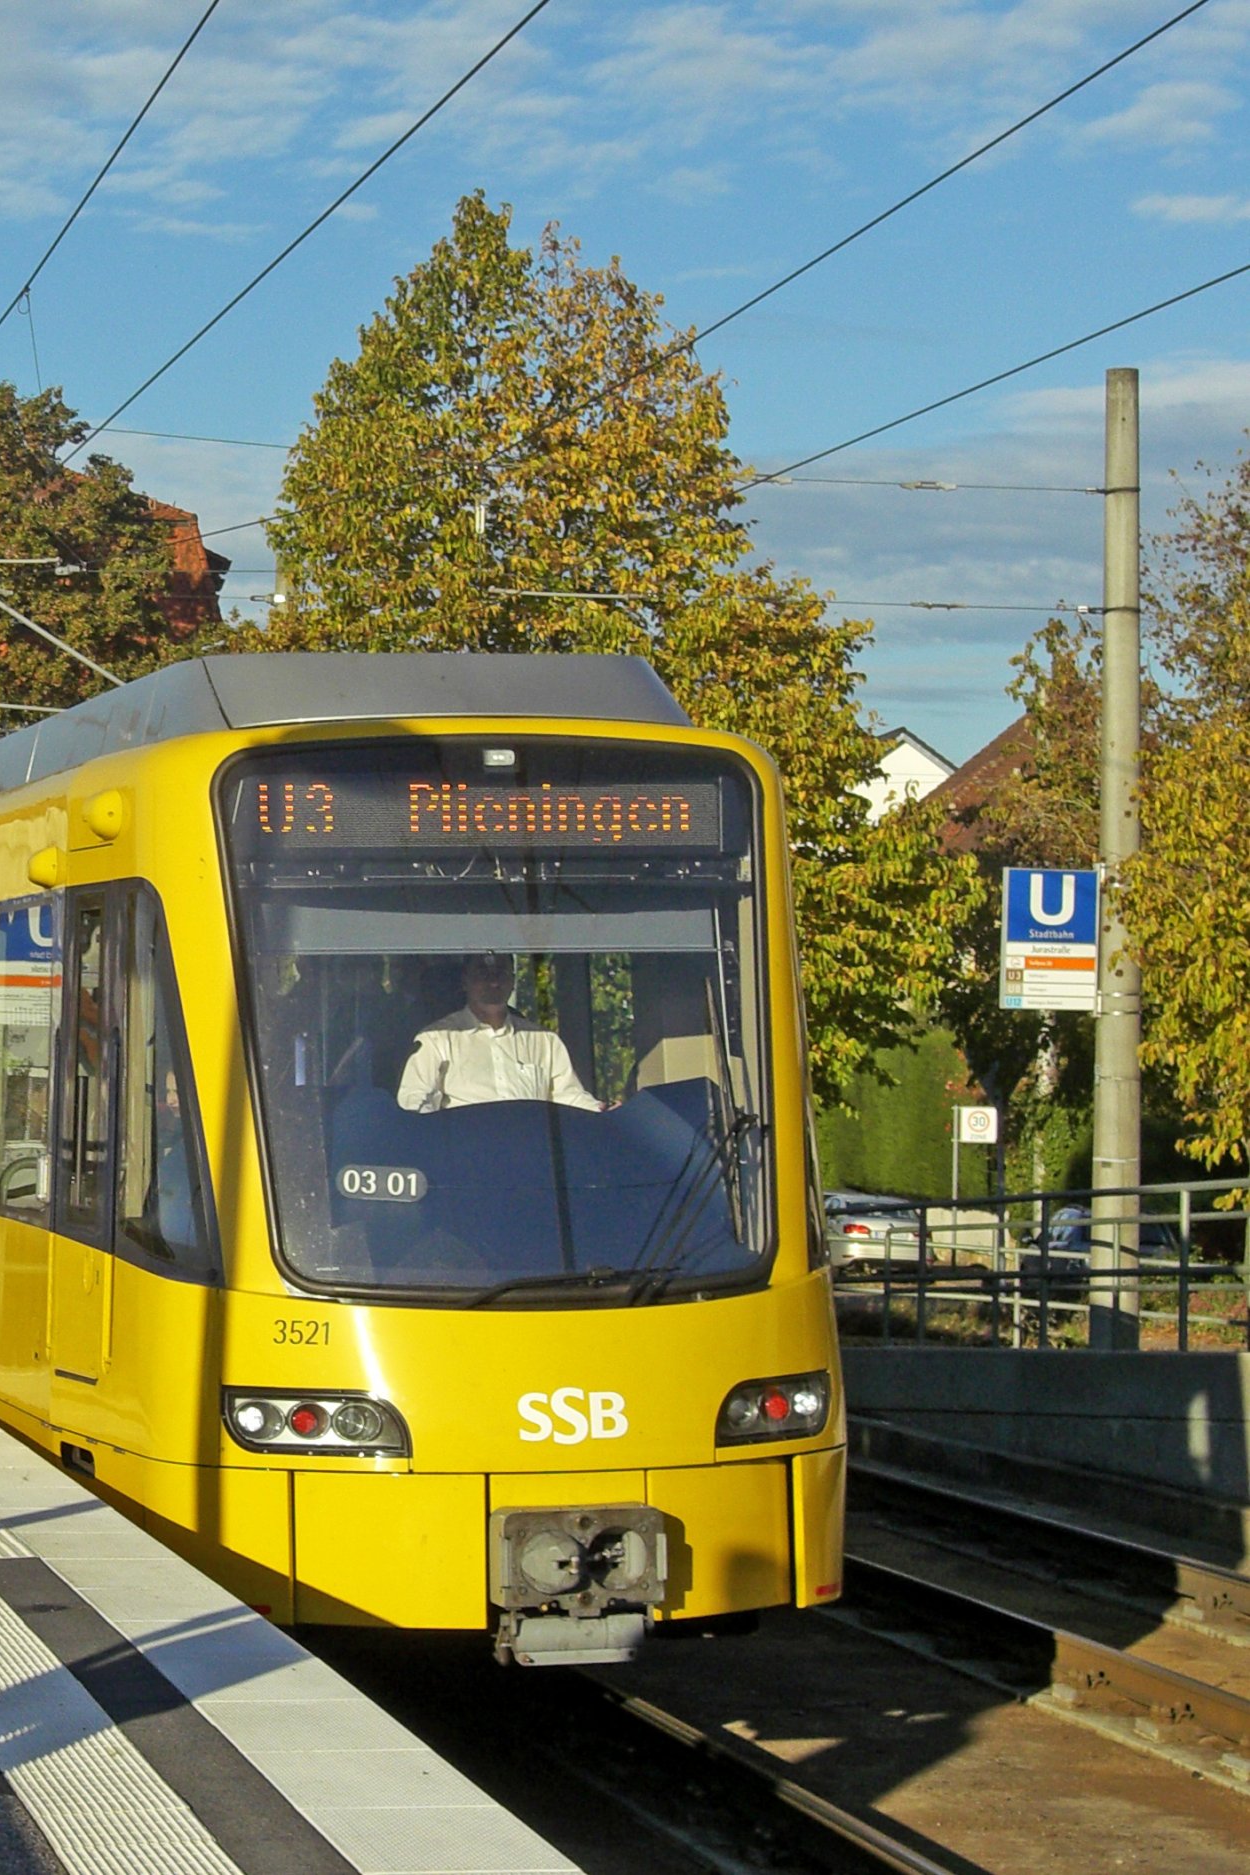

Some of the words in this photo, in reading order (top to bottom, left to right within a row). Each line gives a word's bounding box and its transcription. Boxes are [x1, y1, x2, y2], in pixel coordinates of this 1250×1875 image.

[257, 783, 336, 834] U3
[1030, 873, 1075, 926] U
[1029, 929, 1075, 939] Stadtbahn
[1032, 945, 1071, 955] Jurastraße
[1008, 971, 1021, 980] U3
[1006, 997, 1022, 1006] U12
[972, 1116, 986, 1127] 30
[342, 1170, 377, 1196] 03
[386, 1172, 419, 1198] 01
[272, 1319, 332, 1347] 3521
[516, 1386, 629, 1447] SSB
